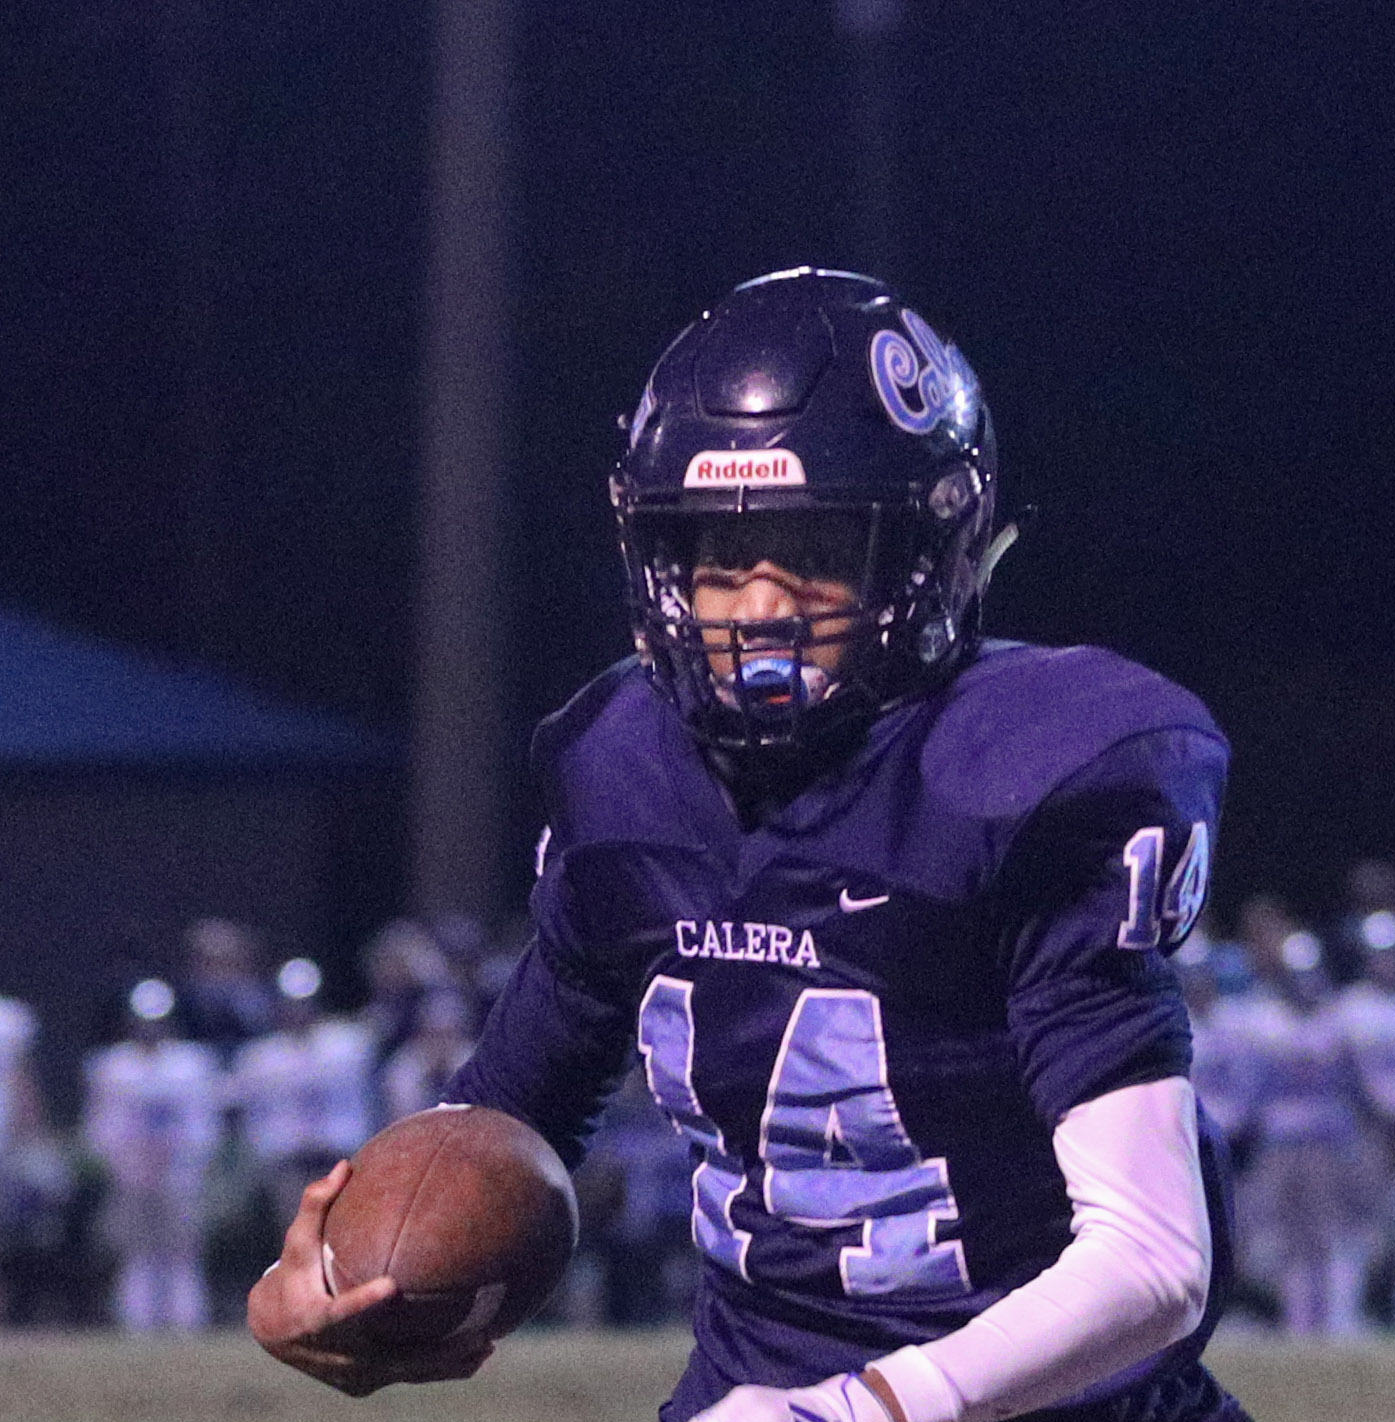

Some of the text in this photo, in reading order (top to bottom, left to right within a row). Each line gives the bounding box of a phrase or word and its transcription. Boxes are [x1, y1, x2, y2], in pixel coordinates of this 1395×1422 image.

[697, 459, 788, 480] Riddell
[1117, 821, 1210, 949] 14
[675, 920, 821, 968] CALERA
[638, 974, 972, 1294] 14
